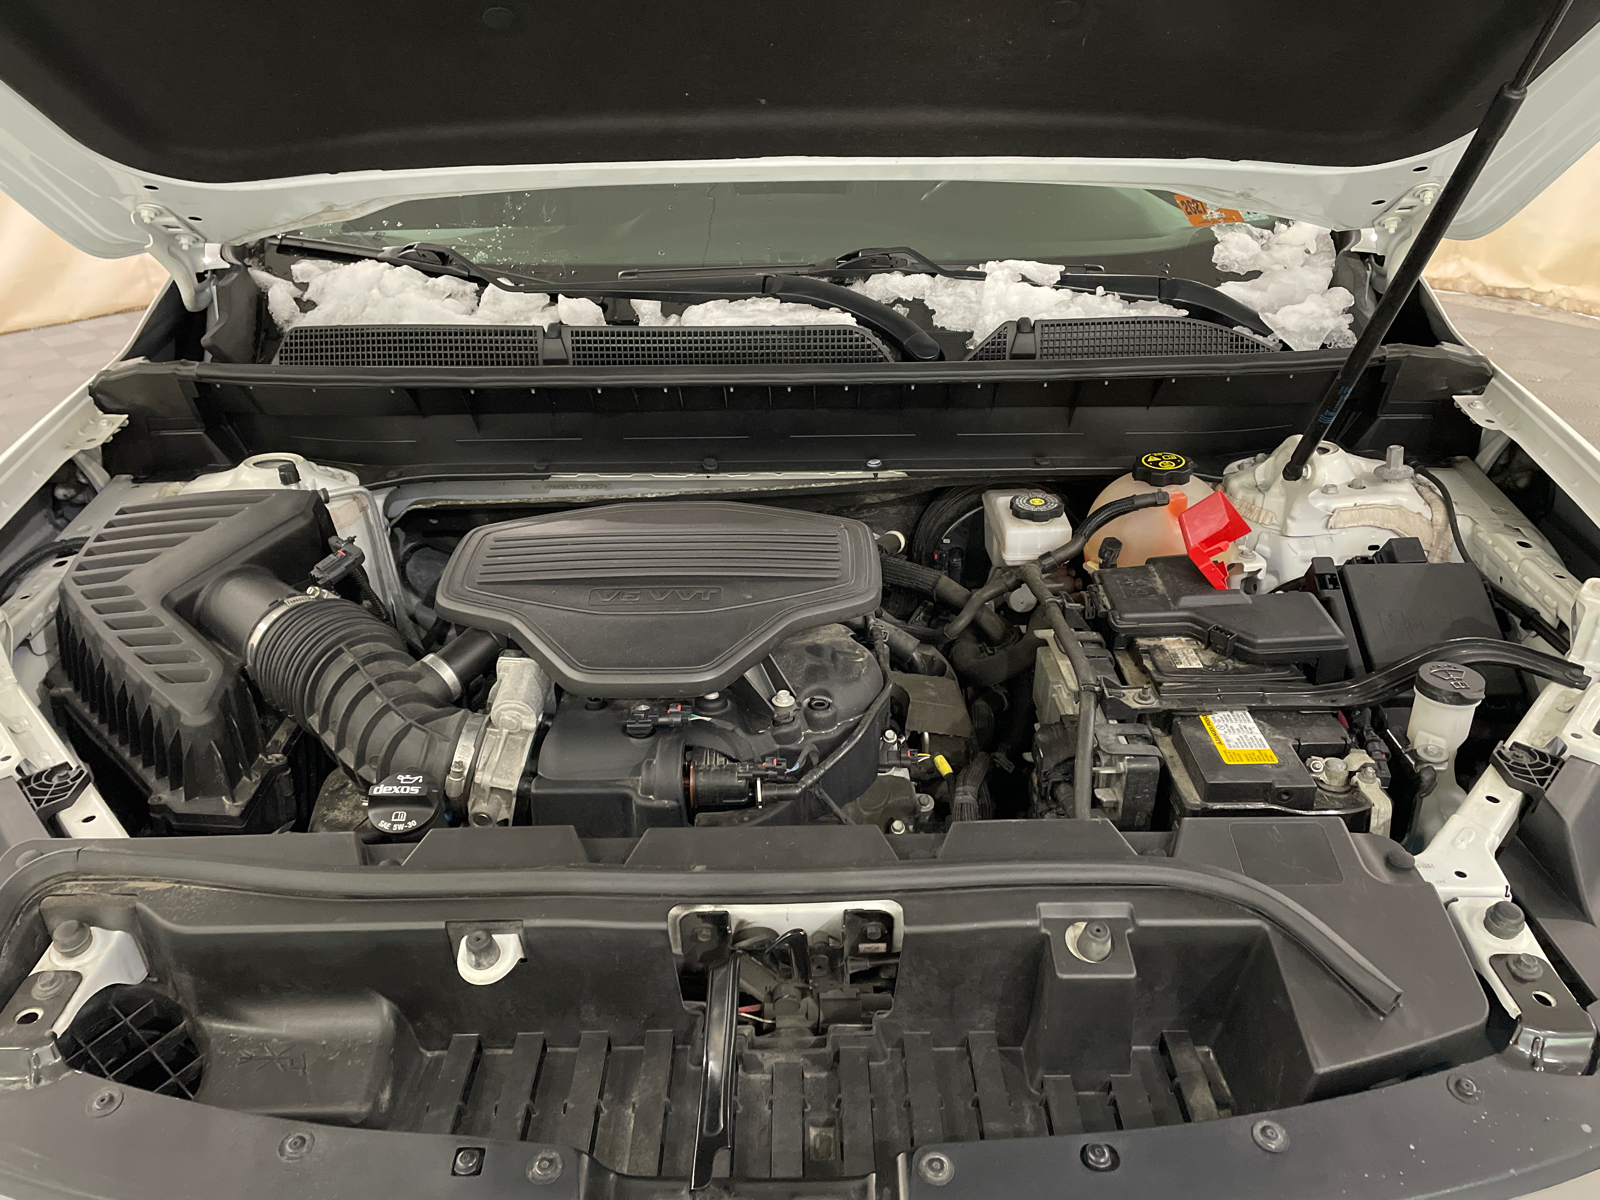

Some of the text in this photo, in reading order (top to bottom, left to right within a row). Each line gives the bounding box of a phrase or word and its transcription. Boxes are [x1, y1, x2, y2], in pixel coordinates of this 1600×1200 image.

[595, 589, 718, 603] V6 VVT
[372, 784, 422, 795] dexos
[378, 820, 417, 831] SAE 5W-30
